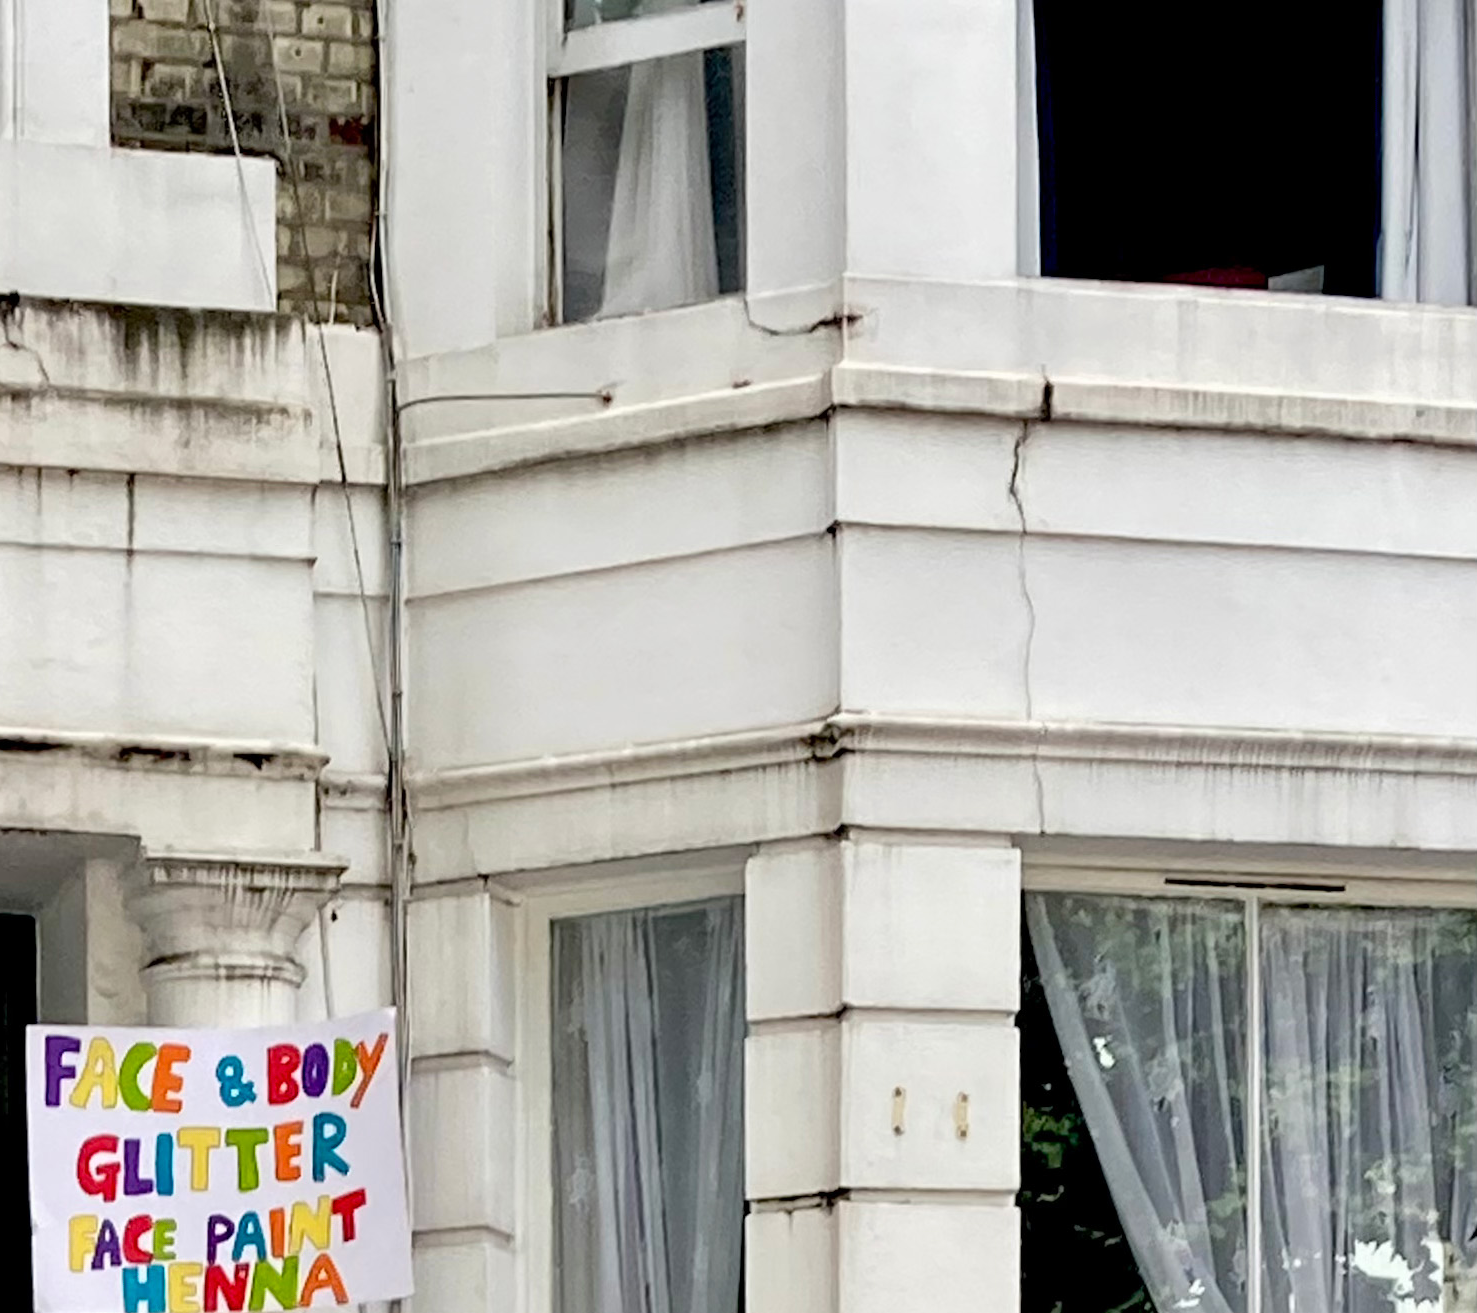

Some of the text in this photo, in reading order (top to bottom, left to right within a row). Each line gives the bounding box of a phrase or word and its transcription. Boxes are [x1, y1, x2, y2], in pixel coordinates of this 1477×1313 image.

[45, 1032, 389, 1113] FACE & BODY
[76, 1112, 350, 1202] GLITTER
[69, 1187, 367, 1273] FACE PAINT
